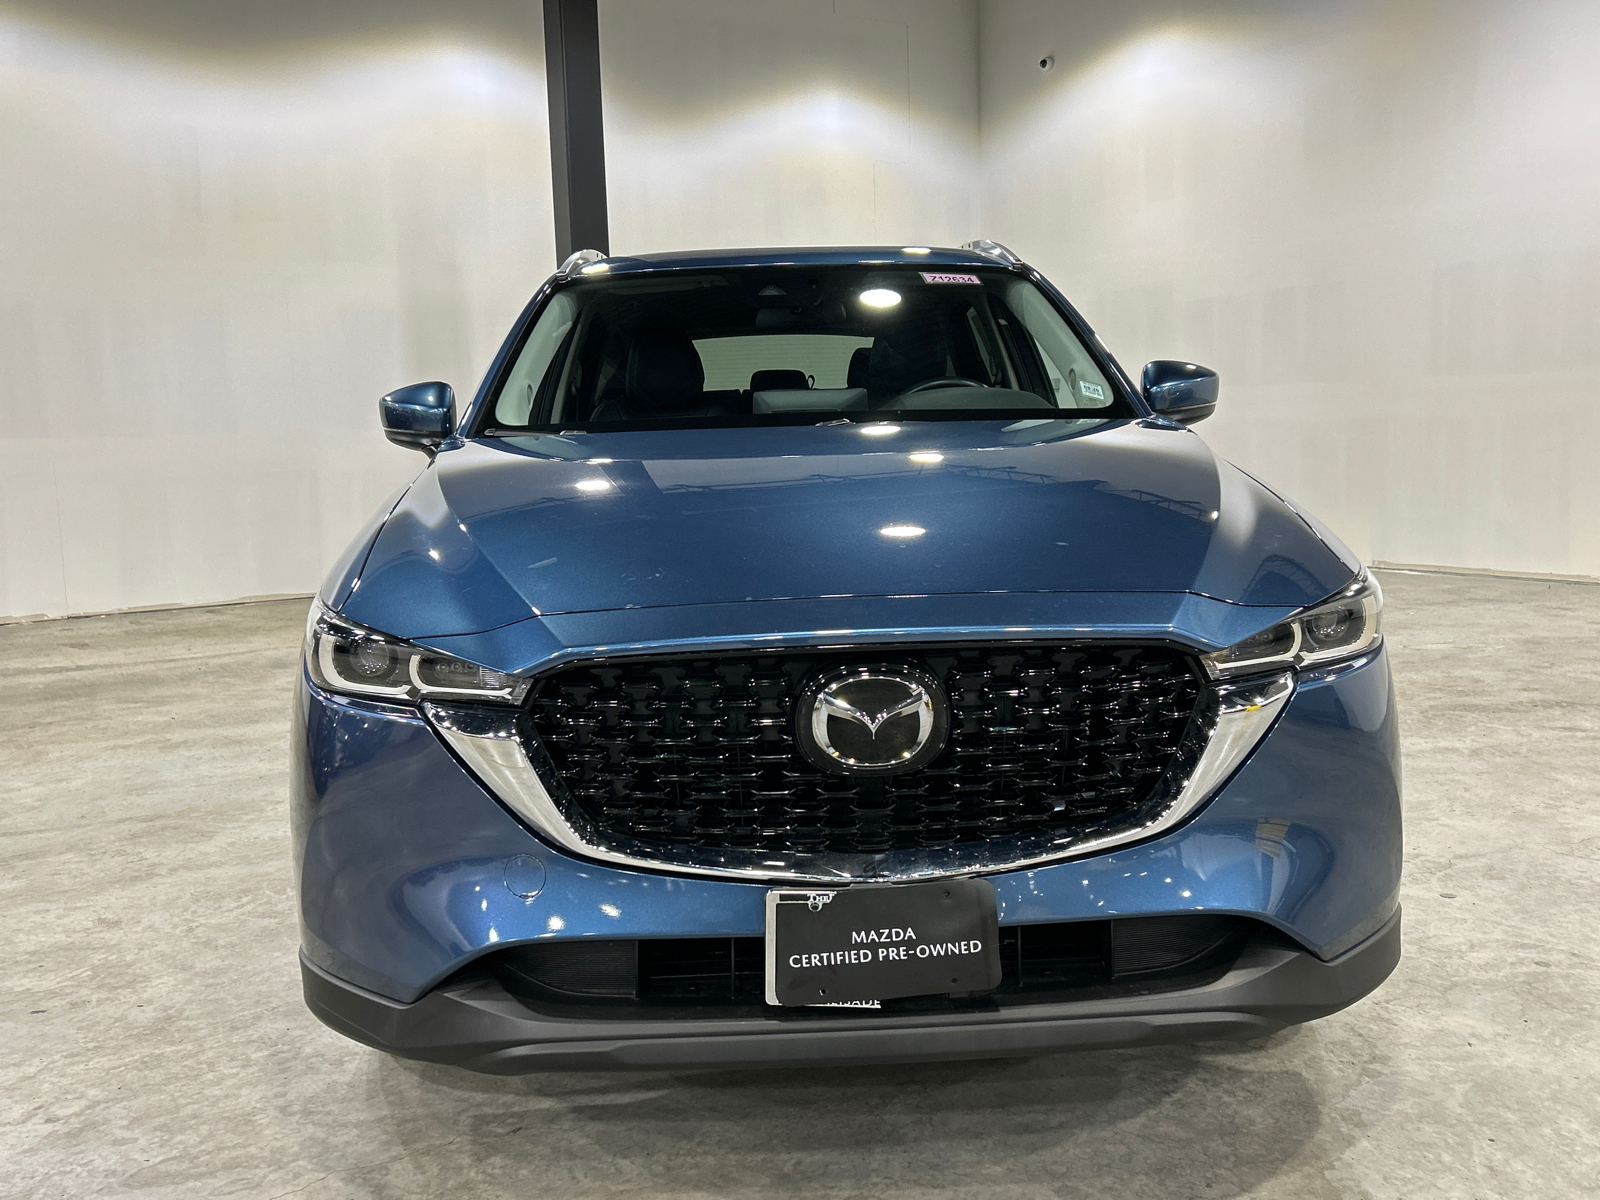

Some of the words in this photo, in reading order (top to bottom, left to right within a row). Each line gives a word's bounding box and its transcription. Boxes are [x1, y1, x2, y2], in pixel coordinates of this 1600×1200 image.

[851, 927, 917, 944] MAZDA
[789, 949, 872, 968] CERTIFIED
[878, 940, 982, 961] PRE-OWNED
